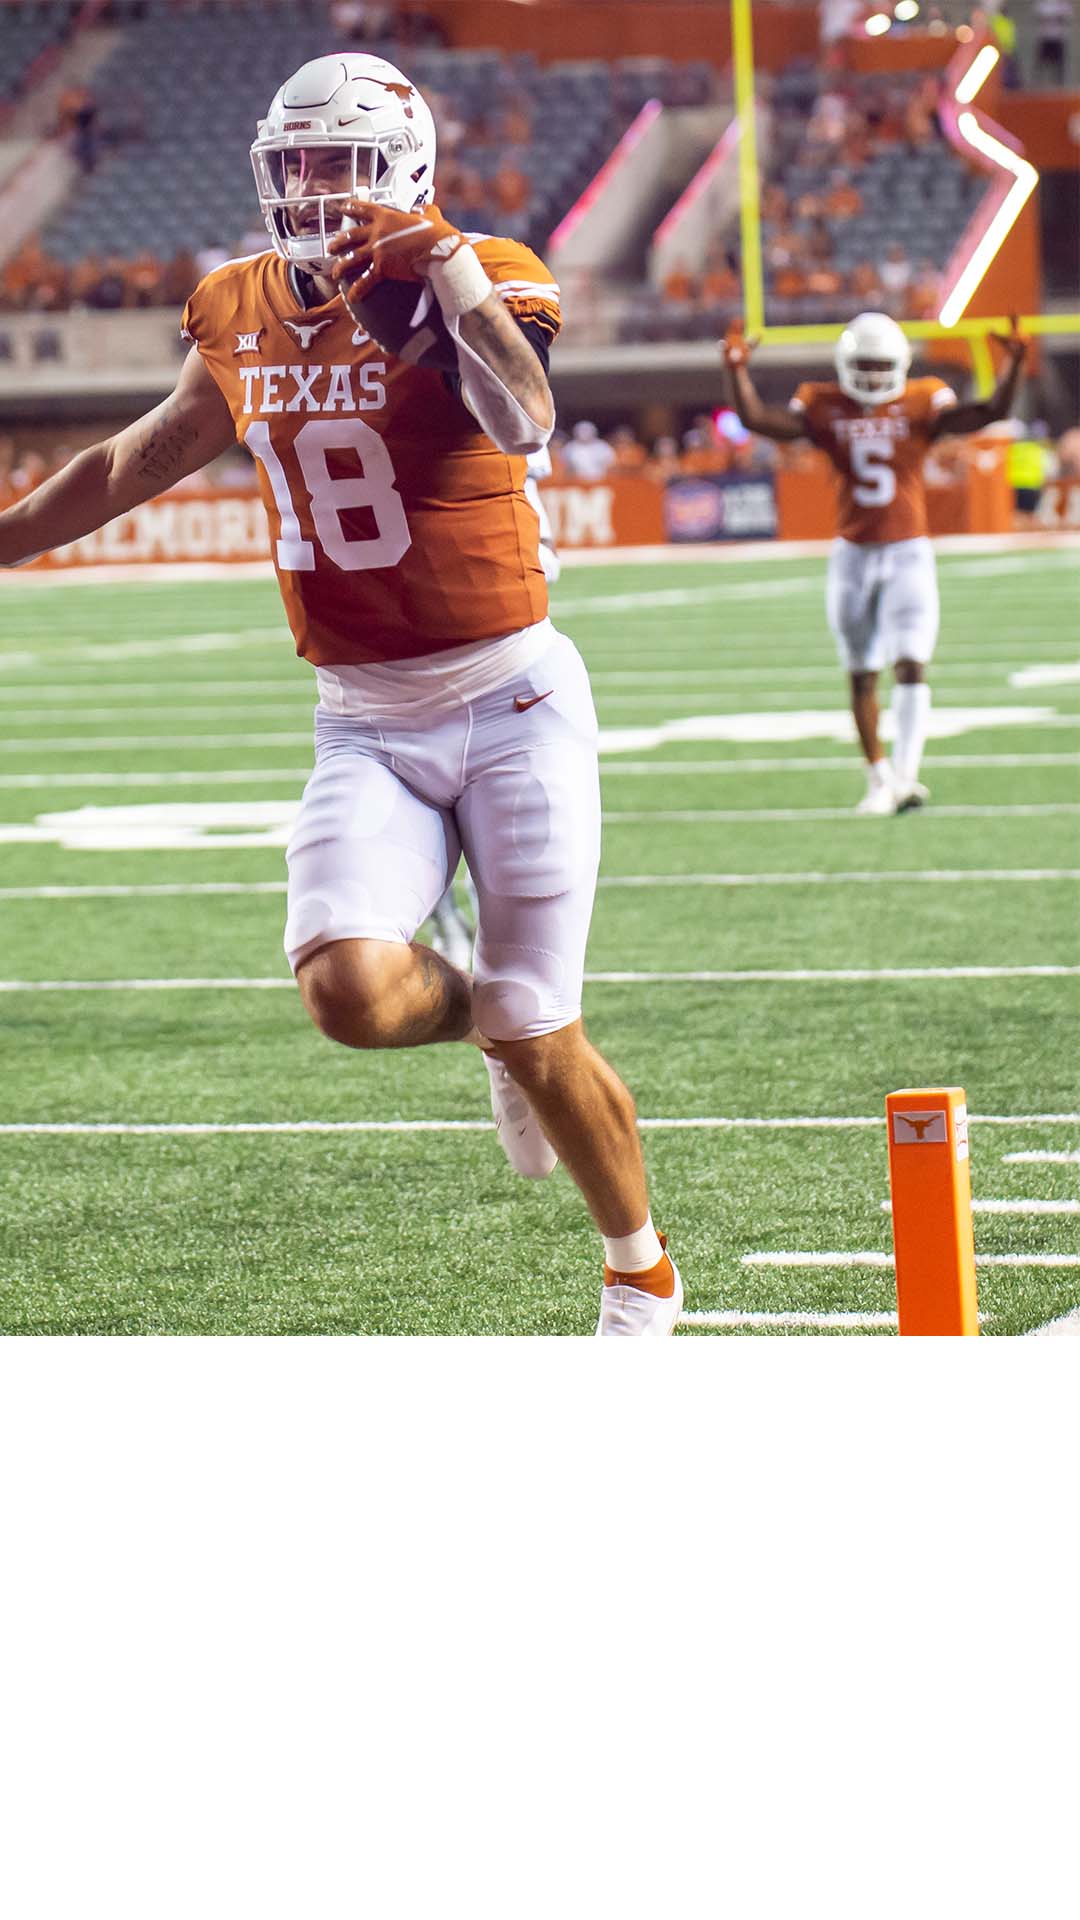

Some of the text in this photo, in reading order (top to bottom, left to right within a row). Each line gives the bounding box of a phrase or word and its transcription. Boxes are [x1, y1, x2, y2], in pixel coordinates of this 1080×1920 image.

[283, 120, 311, 131] HORNS
[239, 362, 387, 414] TEXAS
[244, 418, 412, 571] 18
[851, 437, 896, 507] 5
